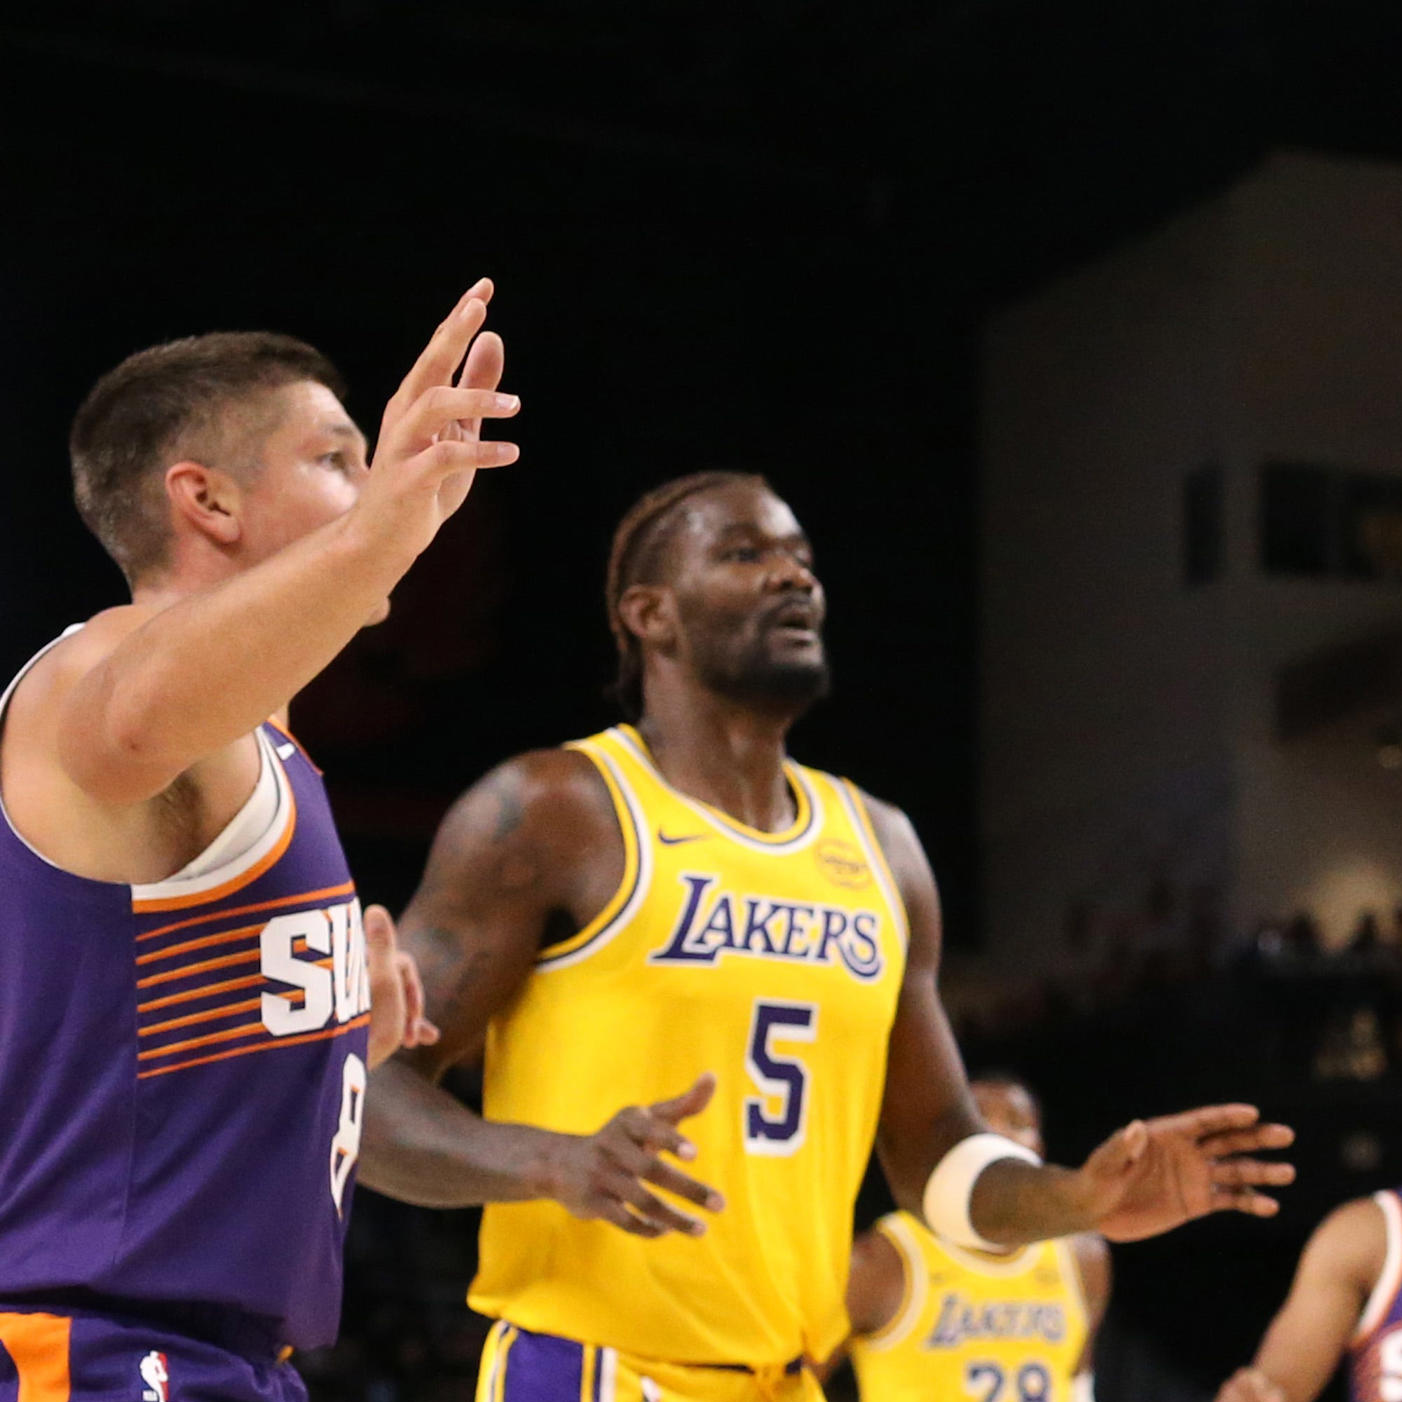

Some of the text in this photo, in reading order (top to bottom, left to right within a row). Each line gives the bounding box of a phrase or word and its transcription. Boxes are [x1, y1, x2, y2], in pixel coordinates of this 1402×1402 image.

[650, 874, 882, 982] LAKERS
[330, 1052, 367, 1222] 8
[745, 998, 817, 1156] 5
